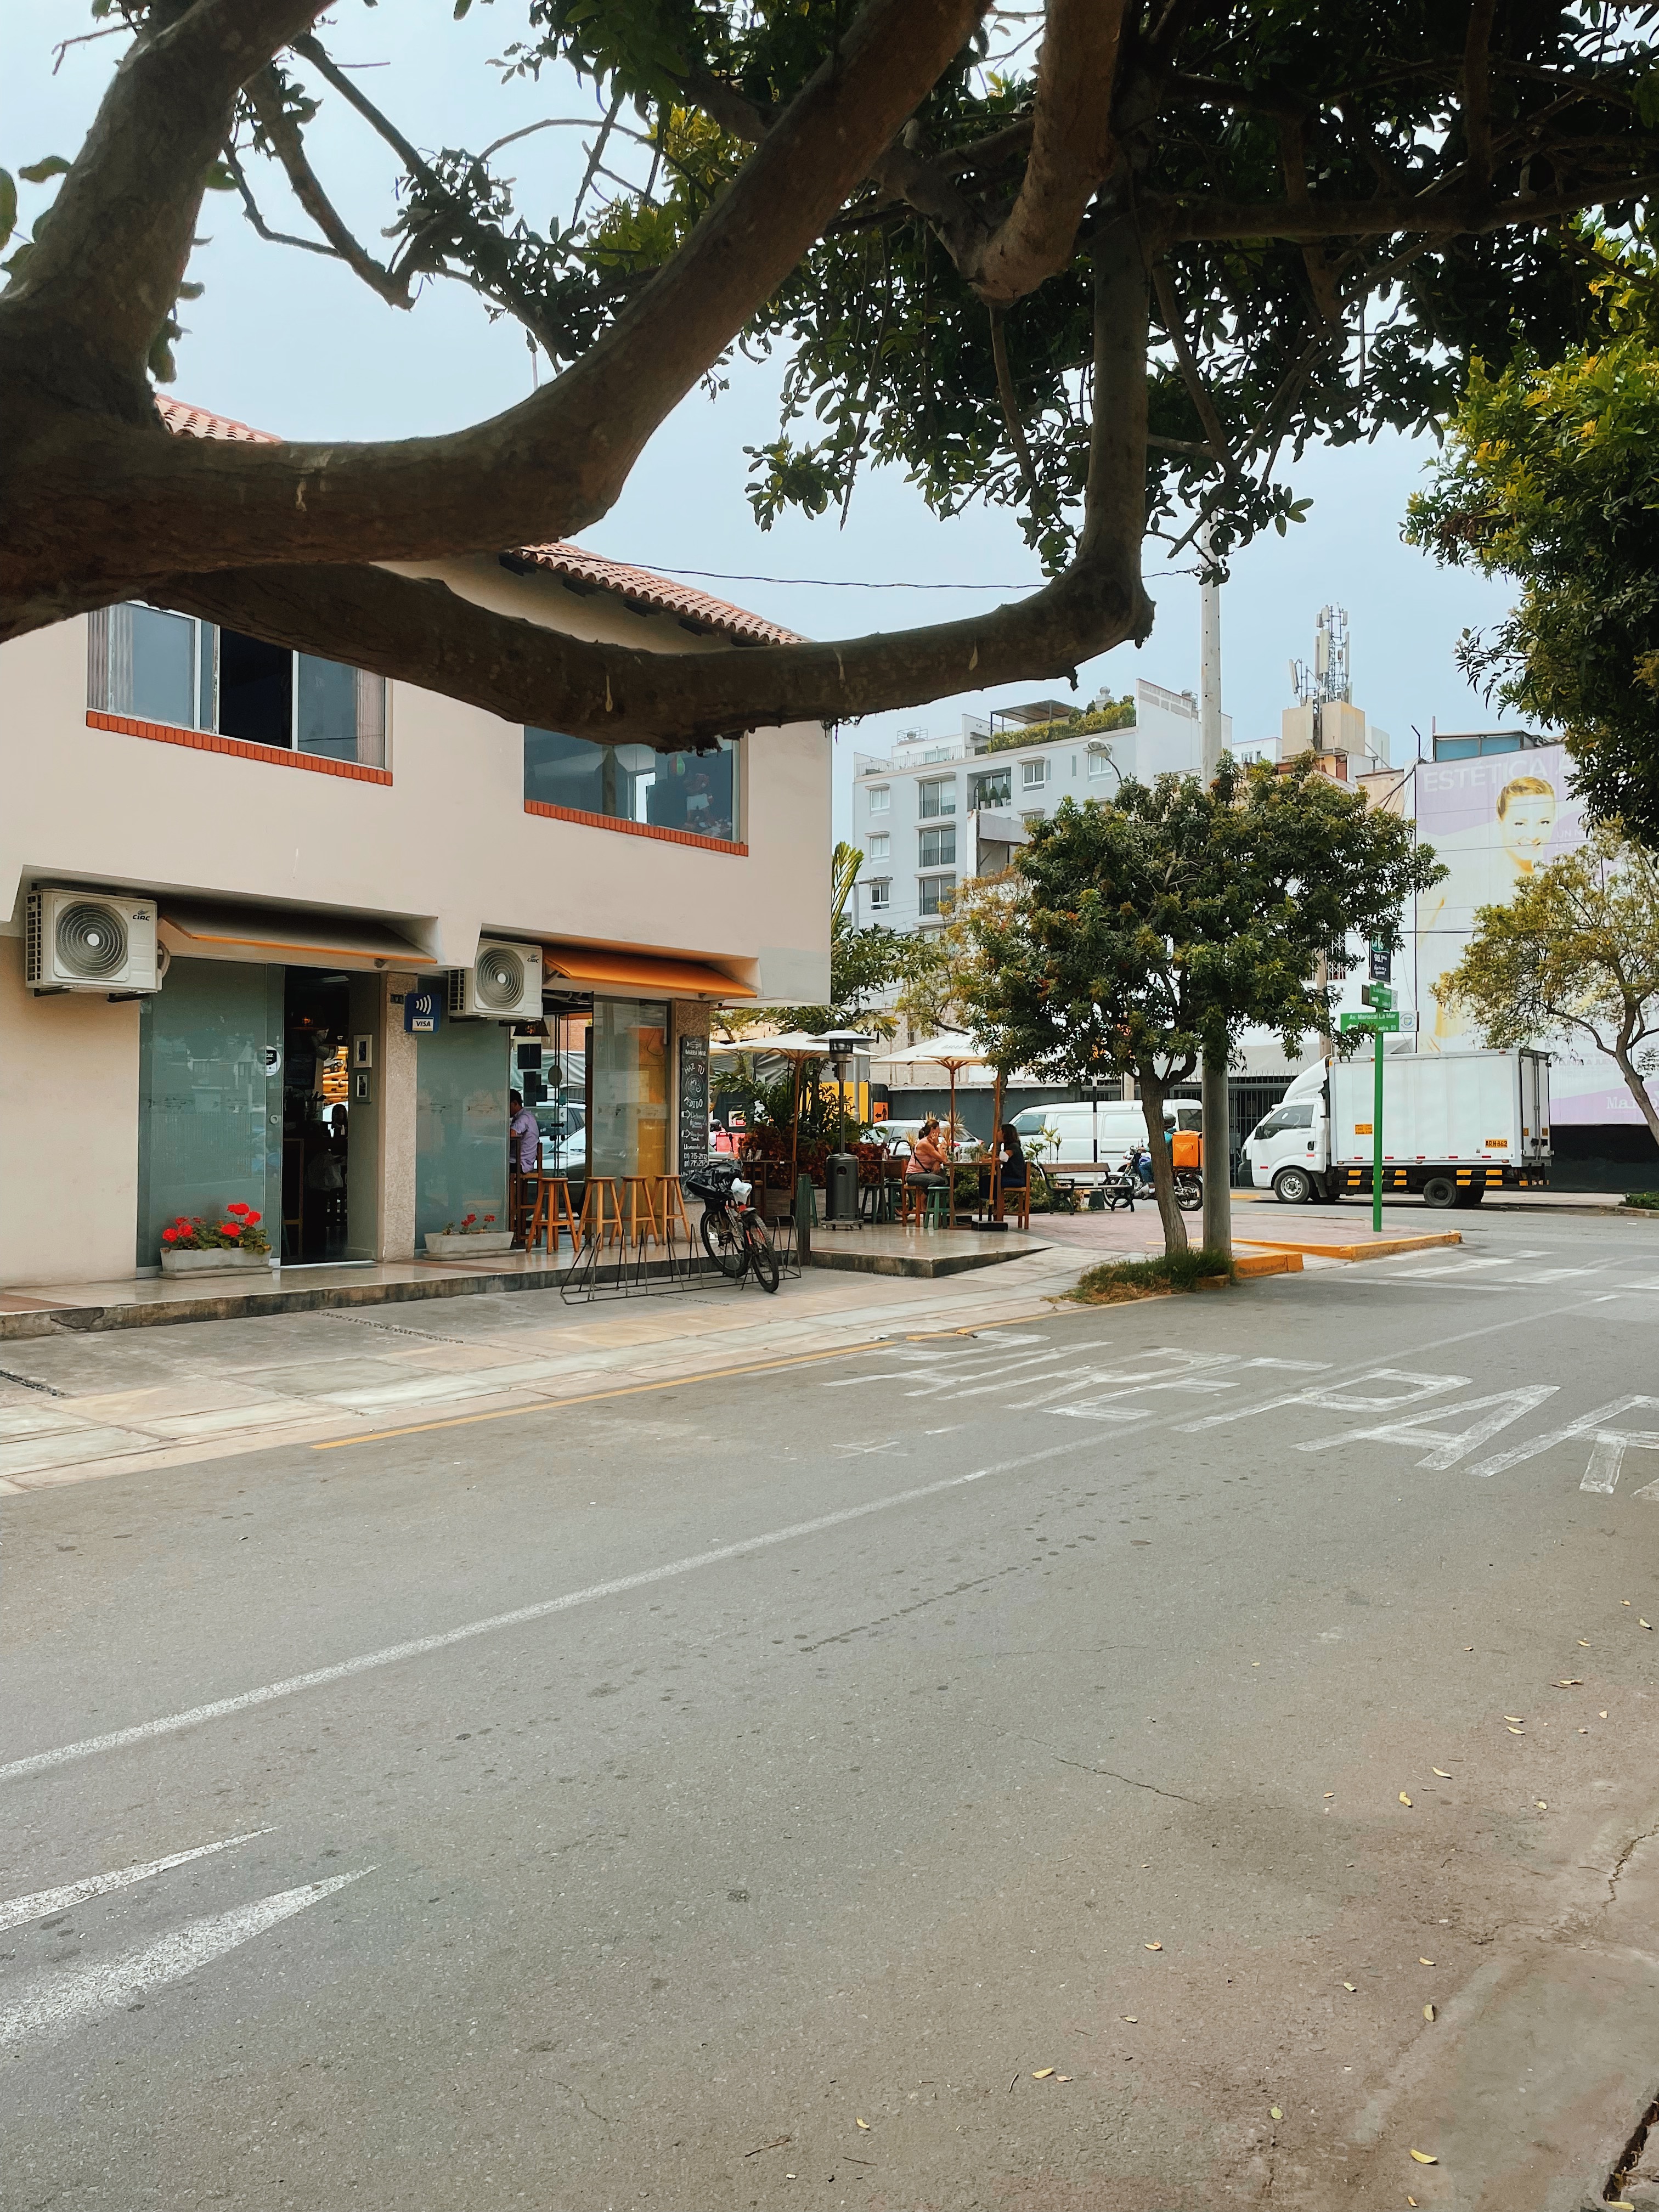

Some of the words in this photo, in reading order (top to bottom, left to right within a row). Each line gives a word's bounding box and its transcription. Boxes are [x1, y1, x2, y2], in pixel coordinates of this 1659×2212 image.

[1424, 757, 1548, 792] ESTÉTICA
[684, 1063, 696, 1074] HAZ
[698, 1064, 705, 1075] TU
[684, 1096, 703, 1109] PEDIDO
[1169, 1367, 1659, 1502] PAR
